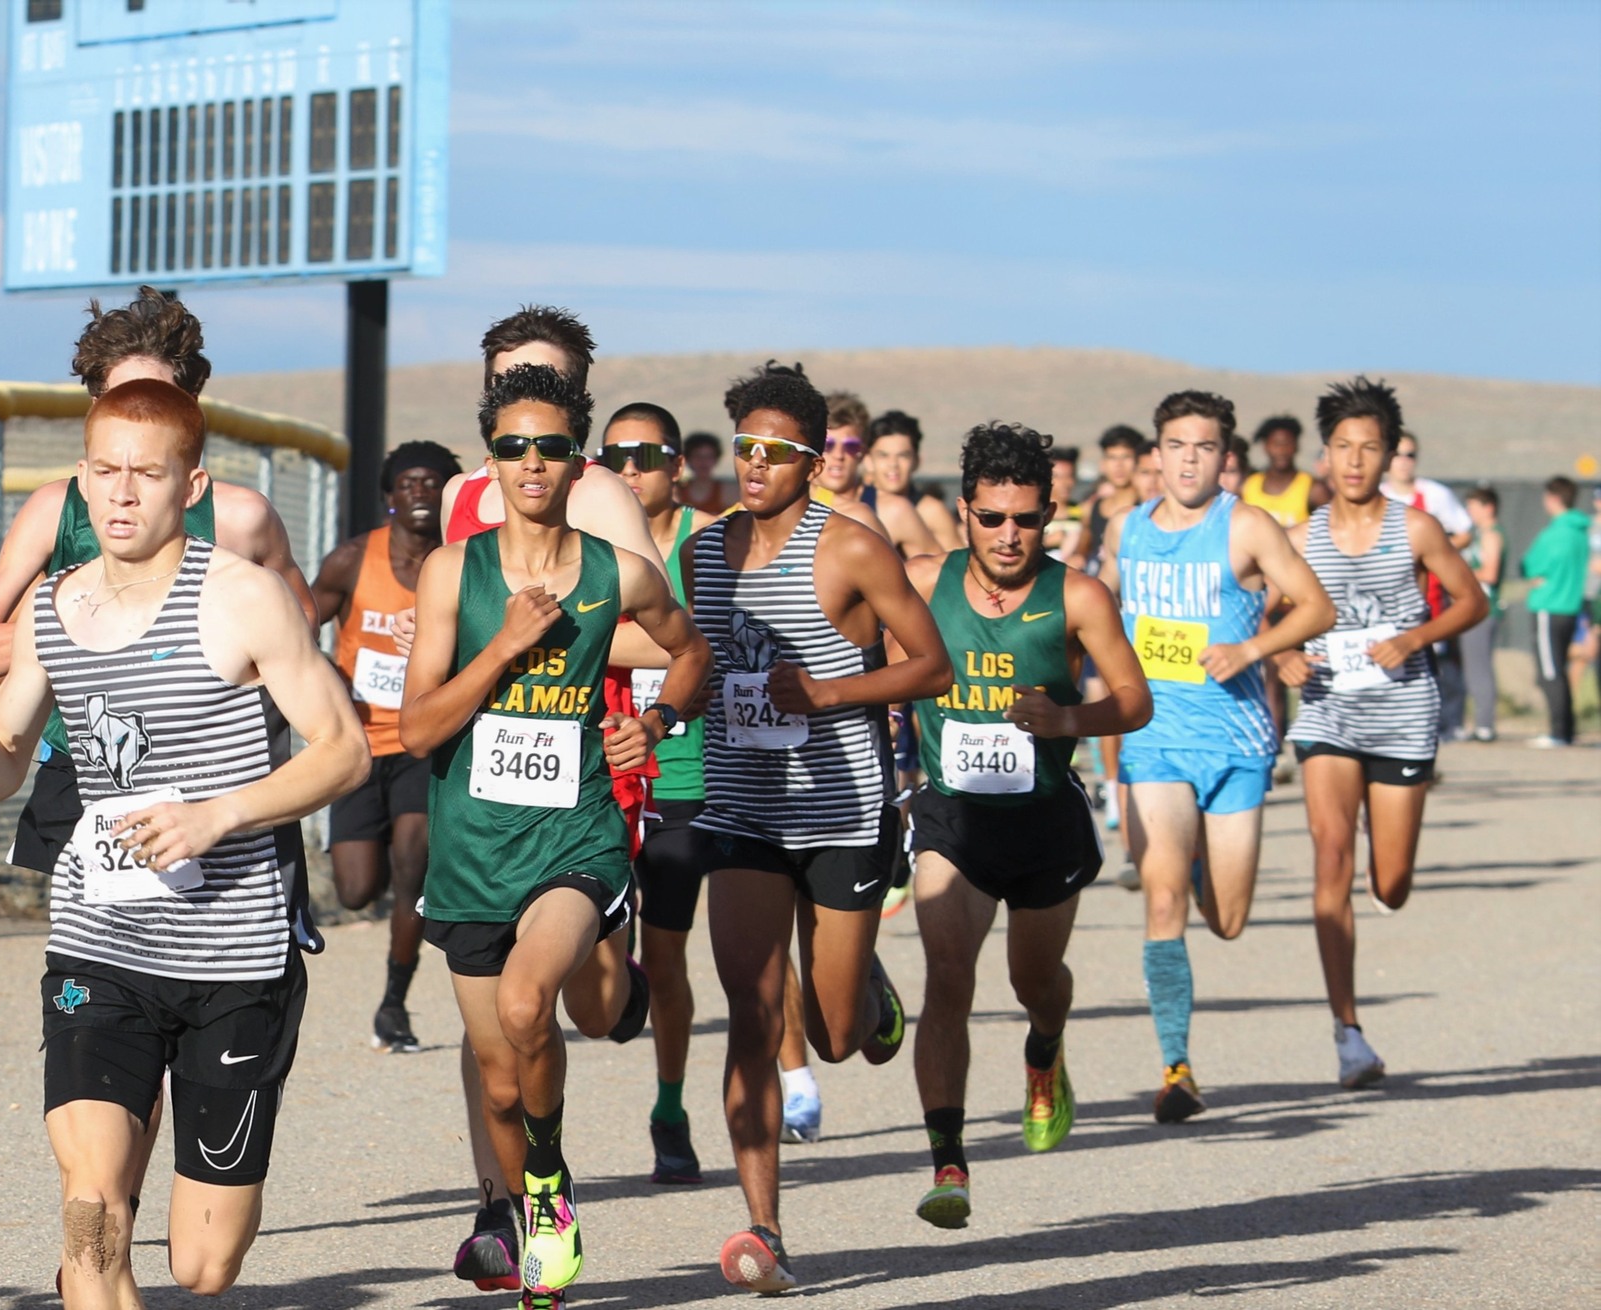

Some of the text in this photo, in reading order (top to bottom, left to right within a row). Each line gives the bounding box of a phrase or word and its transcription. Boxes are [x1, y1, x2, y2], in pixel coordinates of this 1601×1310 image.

[19, 121, 83, 187] VISITOR
[22, 207, 78, 273] HOME
[966, 650, 1016, 678] LOS
[1143, 640, 1193, 665] 5429
[368, 672, 402, 693] 326
[733, 683, 754, 698] Run
[488, 683, 592, 715] LAMOS
[495, 728, 554, 748] Run Fit
[960, 733, 1010, 747] Run Fit
[490, 749, 560, 781] 3469
[957, 750, 1017, 774] 3440
[95, 838, 147, 872] 32
